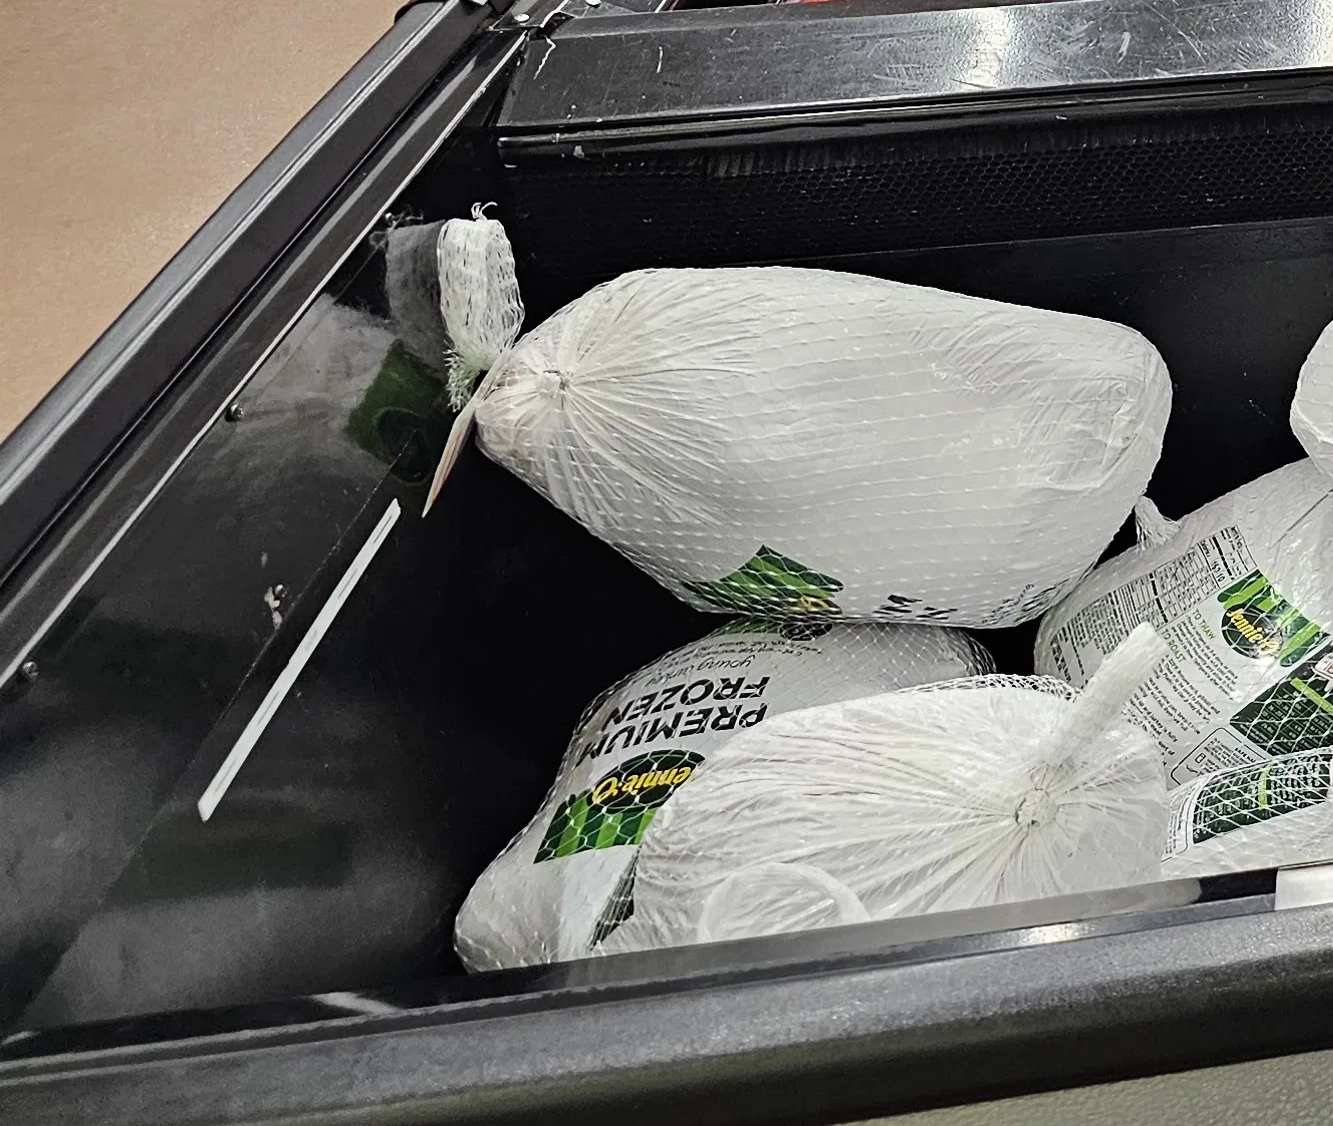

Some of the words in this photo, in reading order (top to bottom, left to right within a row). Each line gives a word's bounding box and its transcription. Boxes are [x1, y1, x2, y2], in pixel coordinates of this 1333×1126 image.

[1193, 608, 1201, 620] TO
[1199, 620, 1216, 641] THAW
[692, 655, 756, 673] young
[1162, 628, 1172, 641] TO
[1167, 639, 1187, 664] ROAST
[602, 676, 771, 726] FROZEN
[575, 702, 769, 768] PREMIUM
[591, 765, 693, 805] ennie-O
